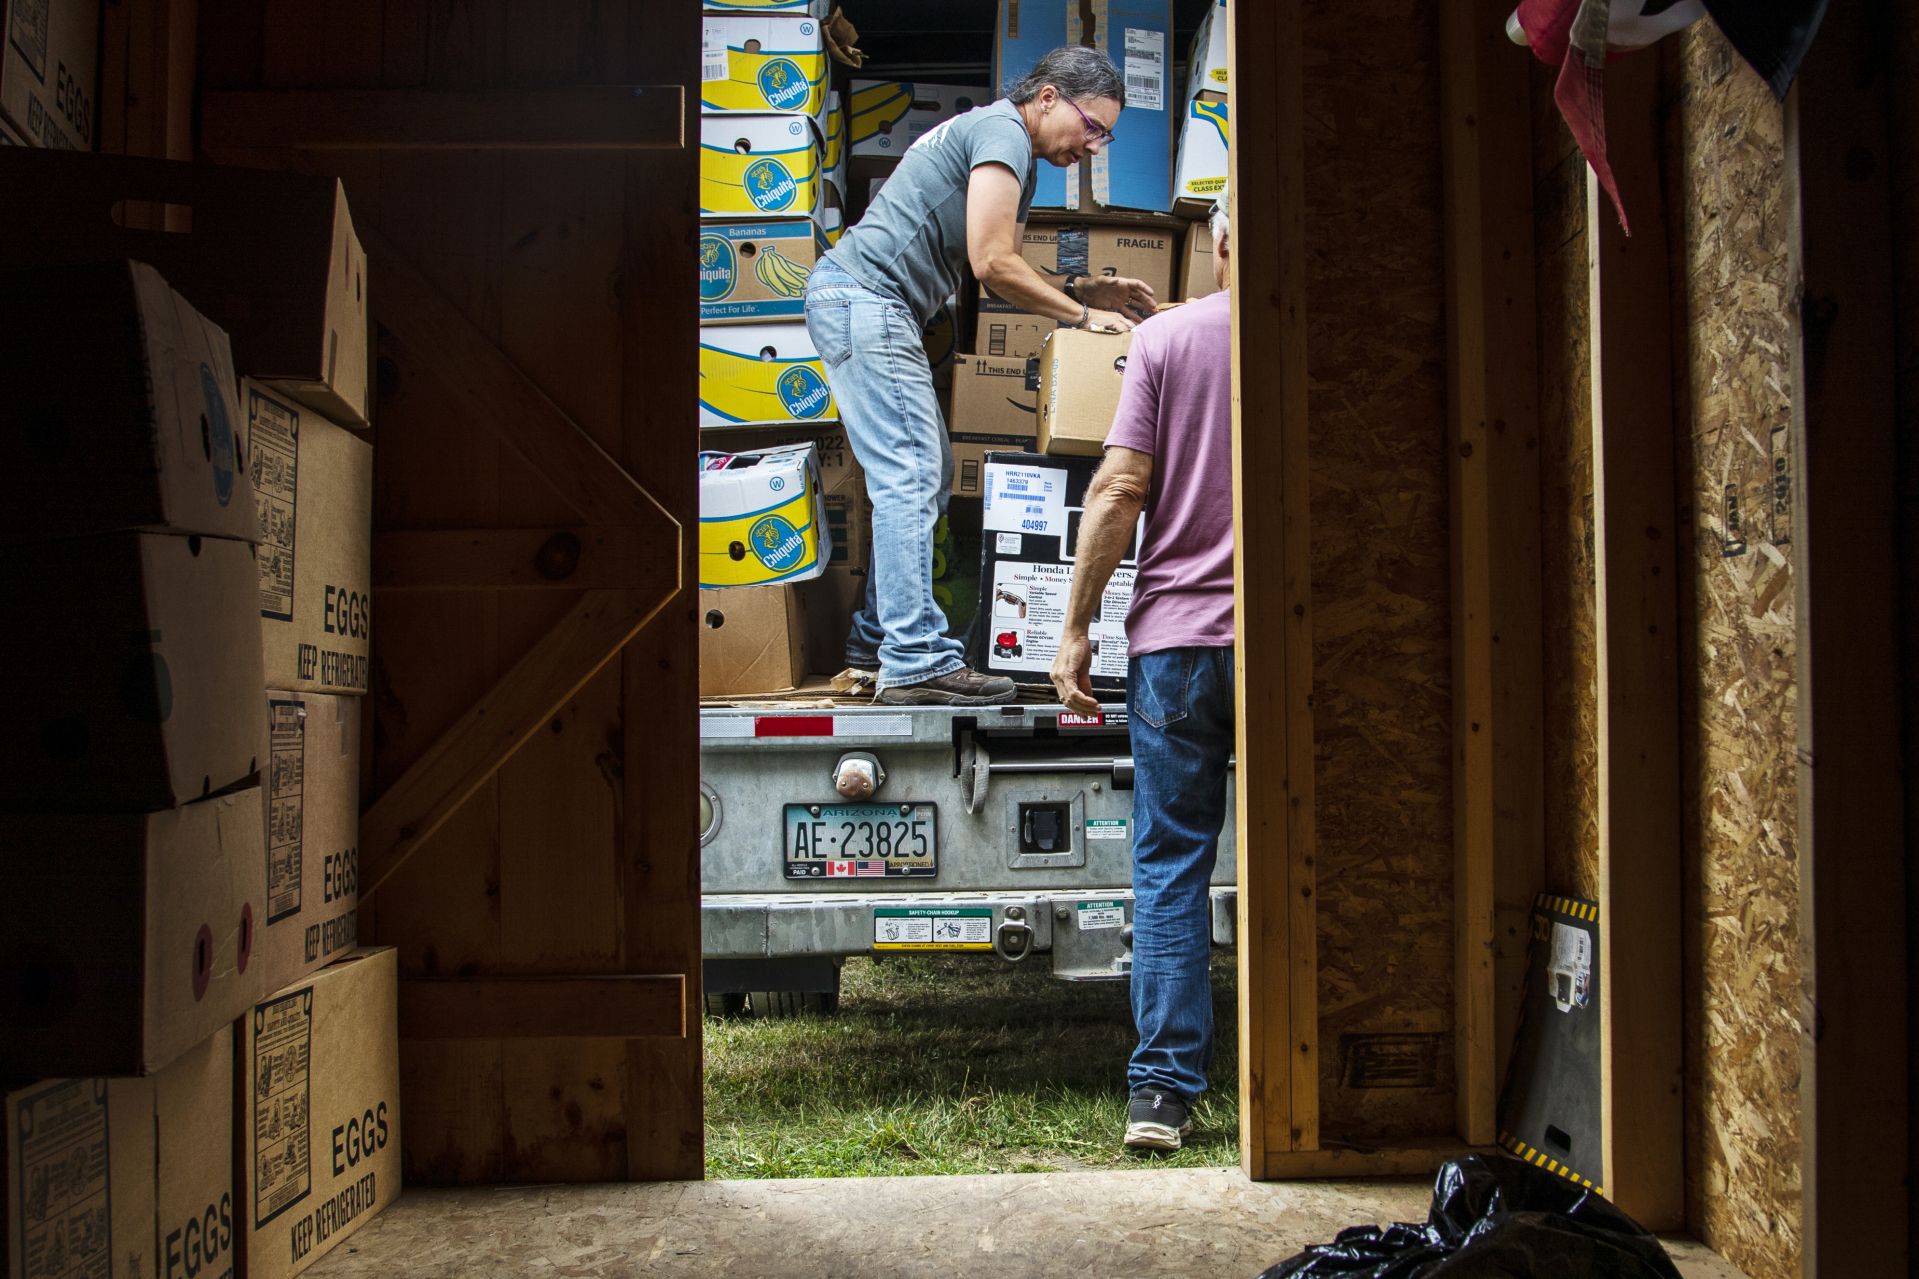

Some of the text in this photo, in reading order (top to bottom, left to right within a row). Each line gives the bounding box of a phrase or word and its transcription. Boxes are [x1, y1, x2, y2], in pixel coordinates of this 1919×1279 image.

[58, 62, 90, 144] EGGS
[768, 79, 808, 107] Chiquita
[755, 177, 795, 208] Chiquita
[729, 227, 767, 237] Bananas
[1117, 238, 1164, 250] FRAGILE
[700, 267, 731, 283] iquita
[700, 305, 727, 315] Perfect
[728, 305, 741, 314] For
[988, 366, 1005, 375] THIS
[1006, 367, 1021, 376] END
[789, 386, 828, 416] Chiquita
[1022, 519, 1048, 531] 404997
[762, 533, 803, 568] Chiquita
[1013, 574, 1038, 583] Simple
[1045, 575, 1067, 584] Money
[1033, 565, 1064, 575] Honda
[325, 584, 369, 640] EGGS
[298, 643, 318, 680] KEEP
[822, 809, 898, 817] ARIZONA
[325, 848, 357, 904] EGGS
[1087, 901, 1114, 909] ATTENTION
[332, 1101, 388, 1178] EGGS
[291, 1172, 377, 1264] KEEP REFRIGERATED
[165, 1192, 233, 1279] EGGS
